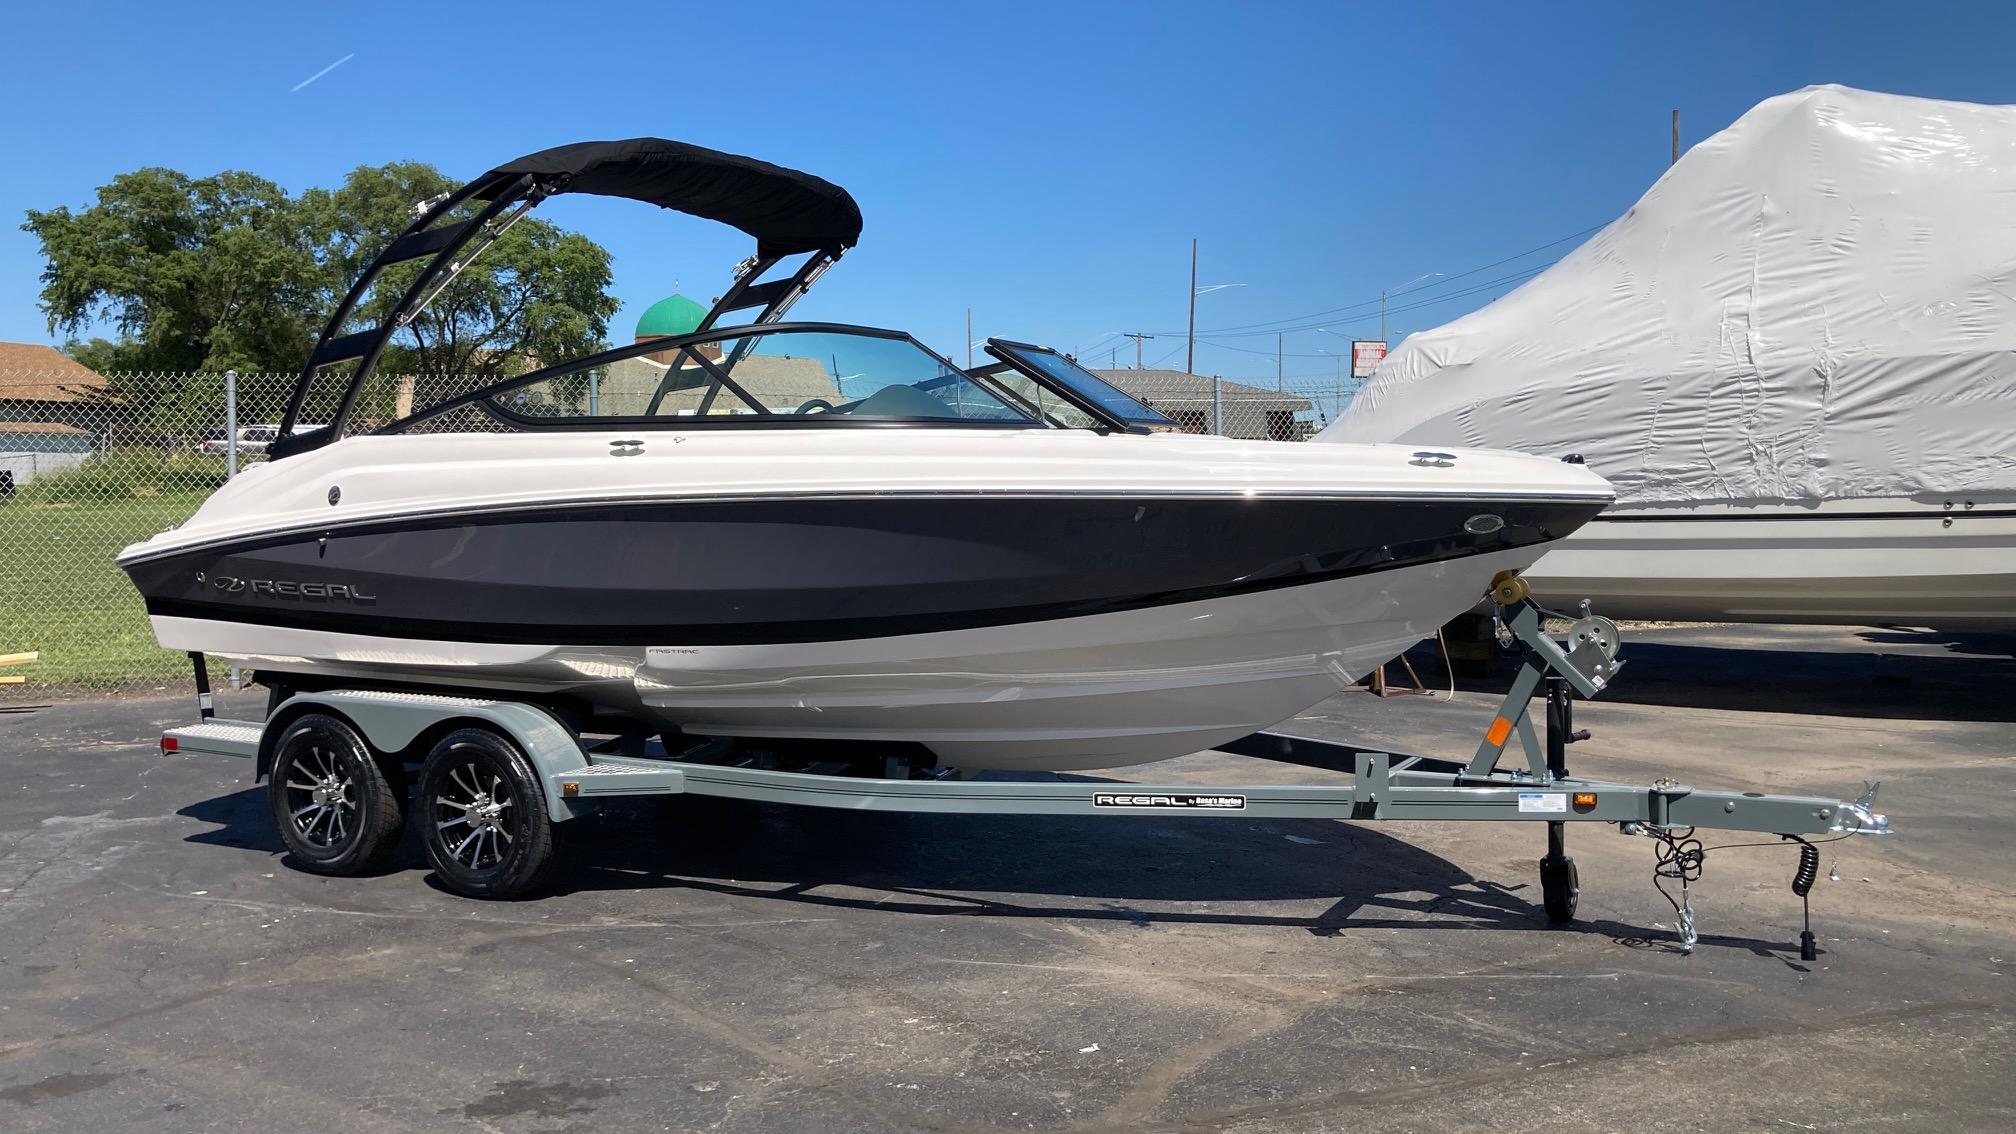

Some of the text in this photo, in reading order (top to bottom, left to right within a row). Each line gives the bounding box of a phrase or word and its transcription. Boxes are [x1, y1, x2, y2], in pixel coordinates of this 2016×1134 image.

[250, 579, 377, 600] REGAL
[1096, 795, 1187, 806] REGAL
[1218, 797, 1242, 805] Marine
